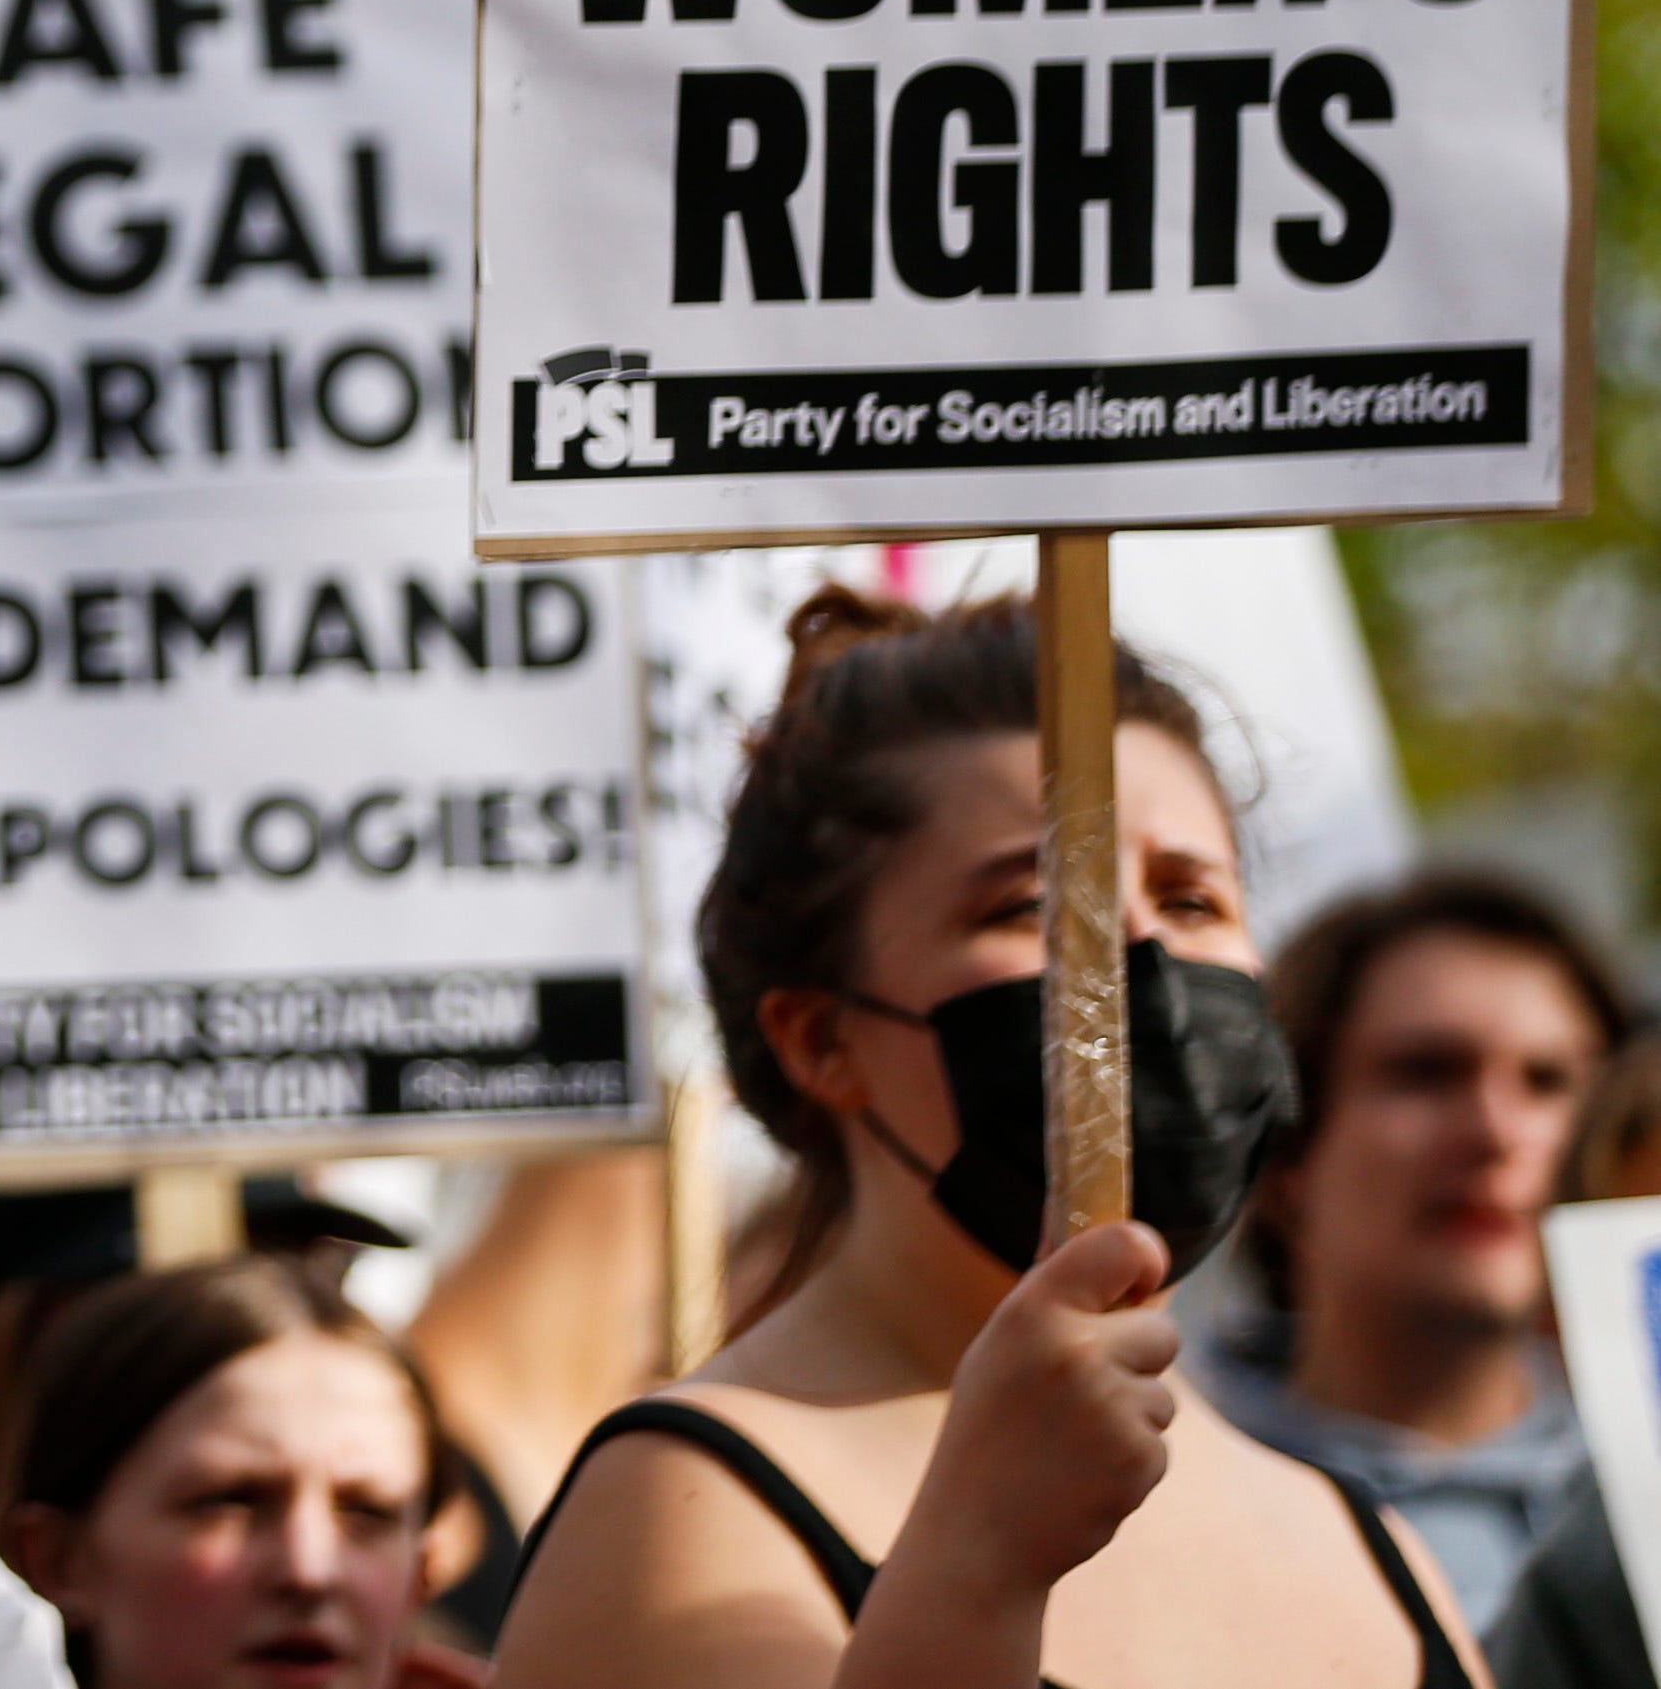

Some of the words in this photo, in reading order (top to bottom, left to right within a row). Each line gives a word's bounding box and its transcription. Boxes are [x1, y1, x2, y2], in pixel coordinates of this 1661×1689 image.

[672, 48, 1395, 304] RIGHTS
[535, 378, 676, 469] PSL
[706, 395, 846, 455] Party
[853, 391, 930, 445] for
[936, 379, 1168, 443] Socialism
[1172, 376, 1256, 434] and
[1261, 372, 1489, 430] Liberation
[68, 986, 199, 1061] FOR
[205, 972, 541, 1056] SOCIALISM
[0, 1054, 369, 1126] LIBERATION
